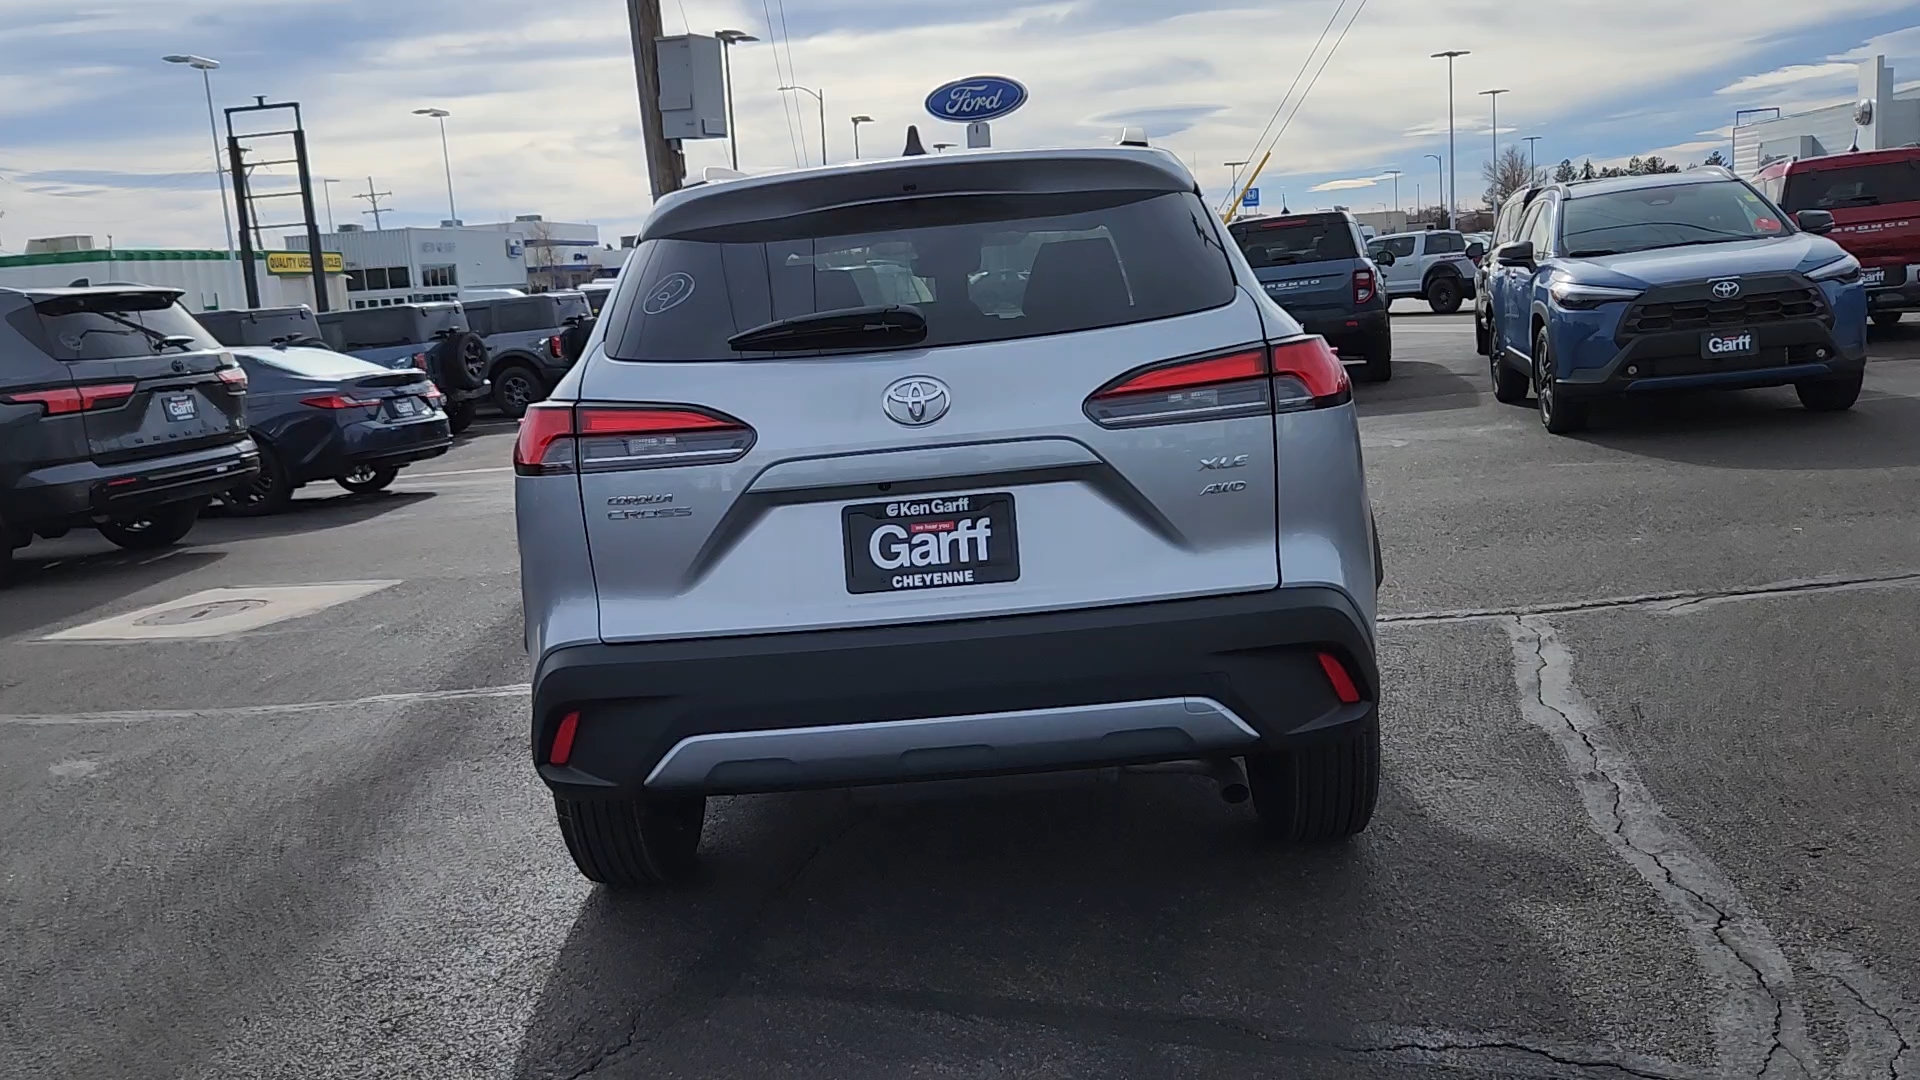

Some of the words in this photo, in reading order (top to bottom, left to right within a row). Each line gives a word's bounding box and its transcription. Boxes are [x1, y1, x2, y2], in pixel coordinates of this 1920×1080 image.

[945, 84, 1003, 114] Ford
[269, 256, 297, 269] QUALITY
[1708, 334, 1751, 353] Garff
[1198, 453, 1249, 472] XLE
[1199, 480, 1247, 496] AWD
[607, 493, 673, 506] COROLLA
[900, 501, 930, 516] Ken
[931, 497, 970, 514] Garff
[607, 506, 692, 520] CROSS
[938, 522, 951, 530] you
[869, 517, 991, 570] Garff
[892, 569, 974, 588] CHEYENNE
